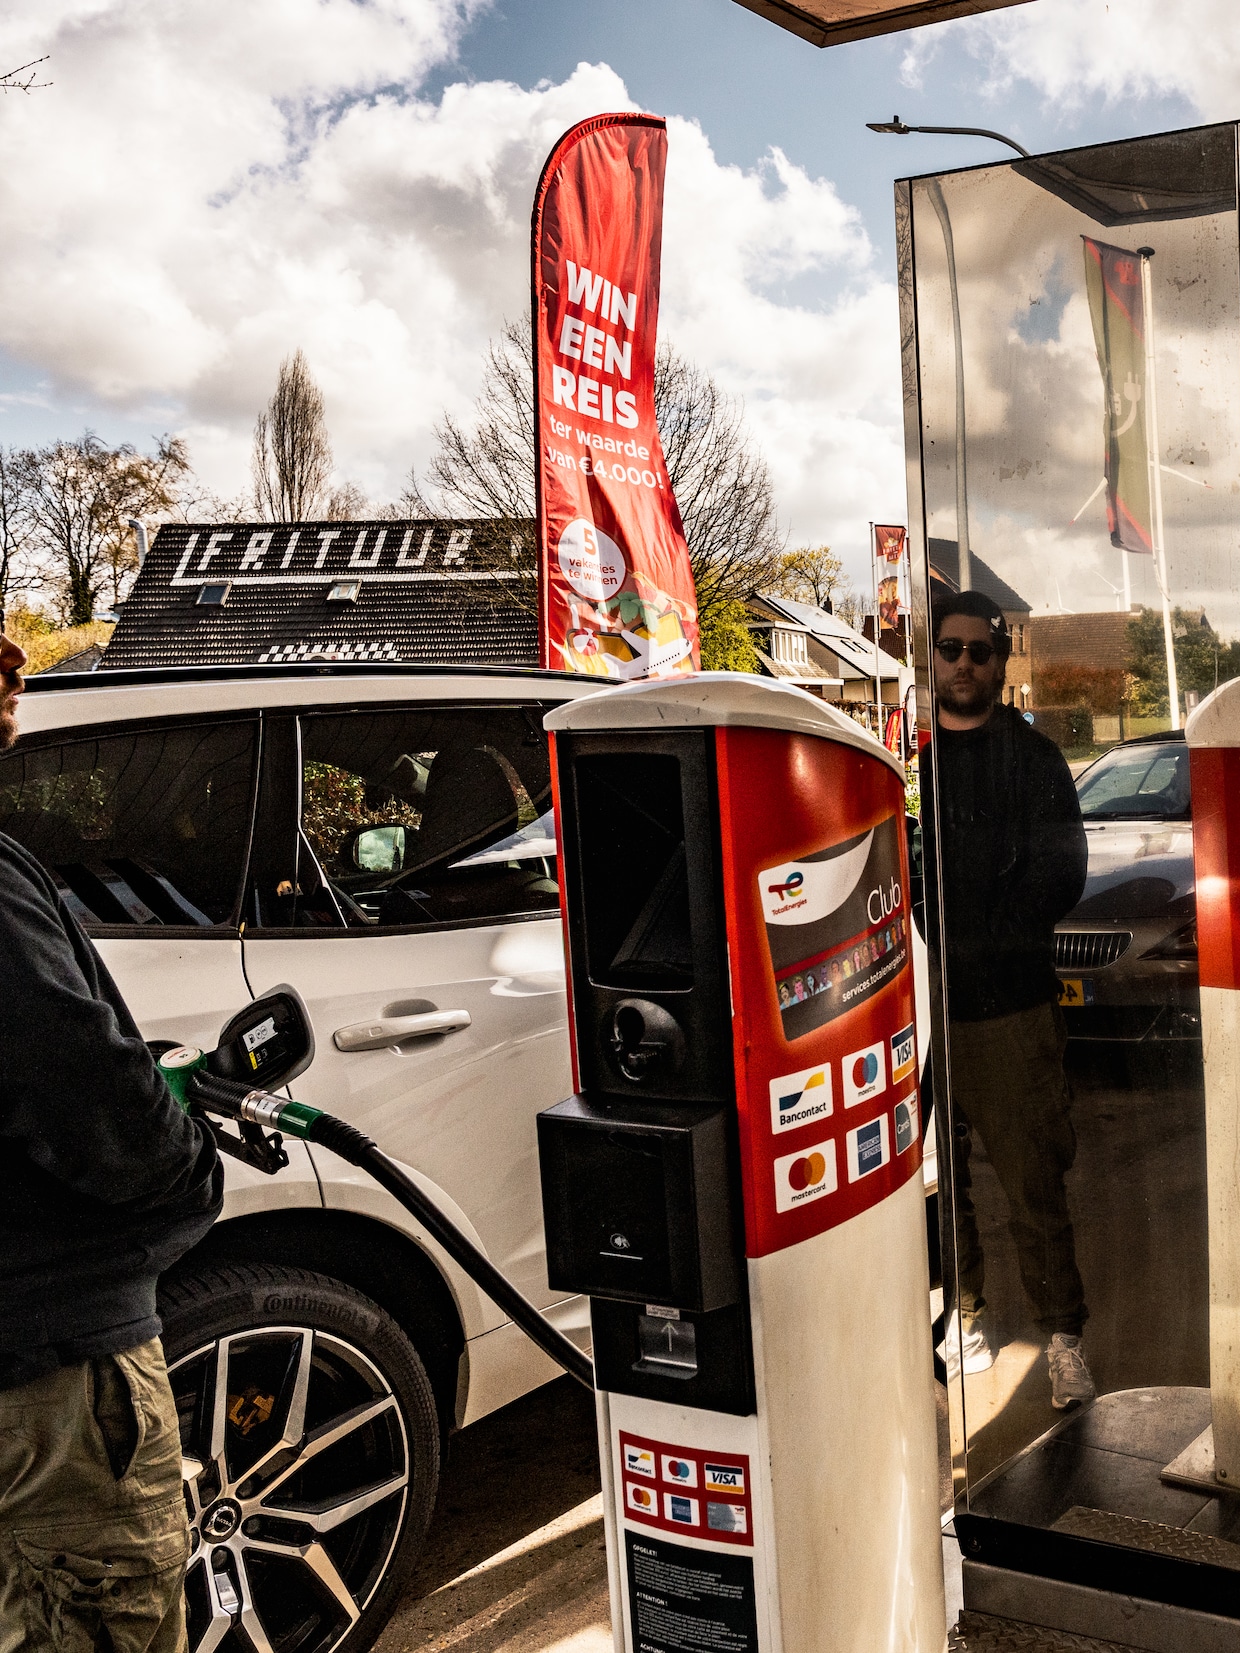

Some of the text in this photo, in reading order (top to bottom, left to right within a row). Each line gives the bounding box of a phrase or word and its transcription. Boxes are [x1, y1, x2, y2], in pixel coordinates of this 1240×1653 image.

[566, 259, 637, 332] WIN
[558, 313, 632, 380] EEN
[552, 363, 639, 429] REIS
[550, 414, 650, 461] ter waarde
[547, 446, 577, 472] van
[583, 528, 597, 556] 5
[568, 568, 581, 579] te
[772, 898, 808, 917] TotalEnergies
[867, 877, 901, 925] Club
[842, 948, 906, 1002] services.totalenergies.be
[896, 1041, 912, 1066] VISA
[780, 1102, 827, 1126] Bancontact
[791, 1182, 826, 1203] mastercard
[712, 1472, 737, 1485] VISA
